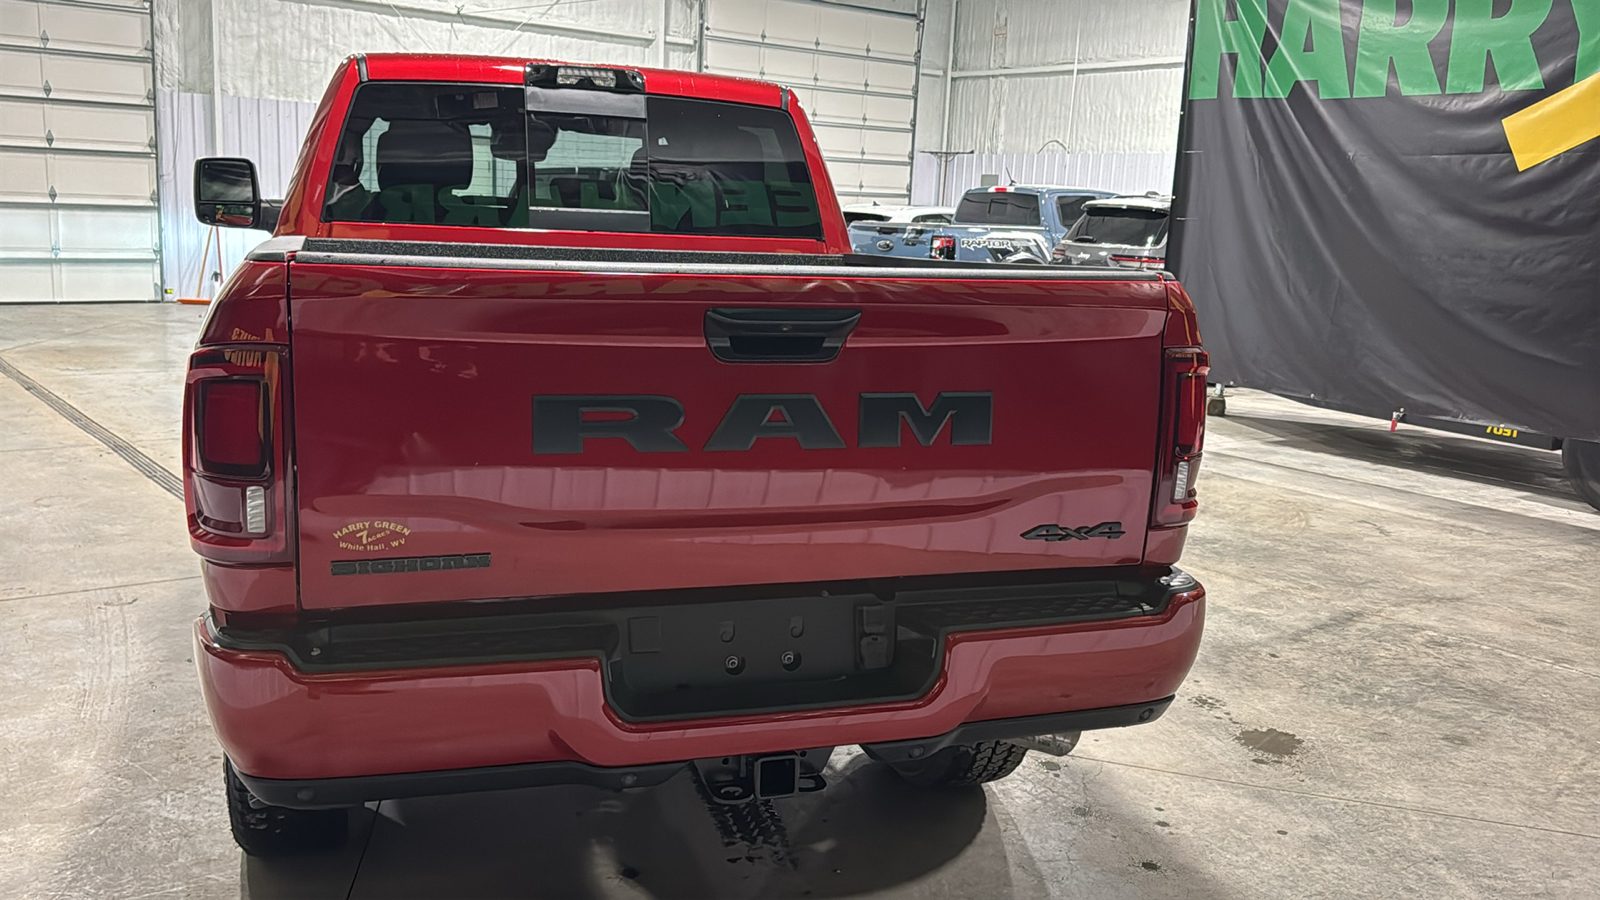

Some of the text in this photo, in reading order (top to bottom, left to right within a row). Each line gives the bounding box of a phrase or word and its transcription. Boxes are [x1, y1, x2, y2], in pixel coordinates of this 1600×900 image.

[1189, 0, 1600, 100] HARR
[961, 238, 1014, 252] RAPTOR
[532, 391, 993, 454] RAM
[333, 521, 411, 539] HARRY GREEN
[356, 530, 390, 545] 7 ACRES
[339, 541, 364, 551] White
[390, 538, 405, 547] WV
